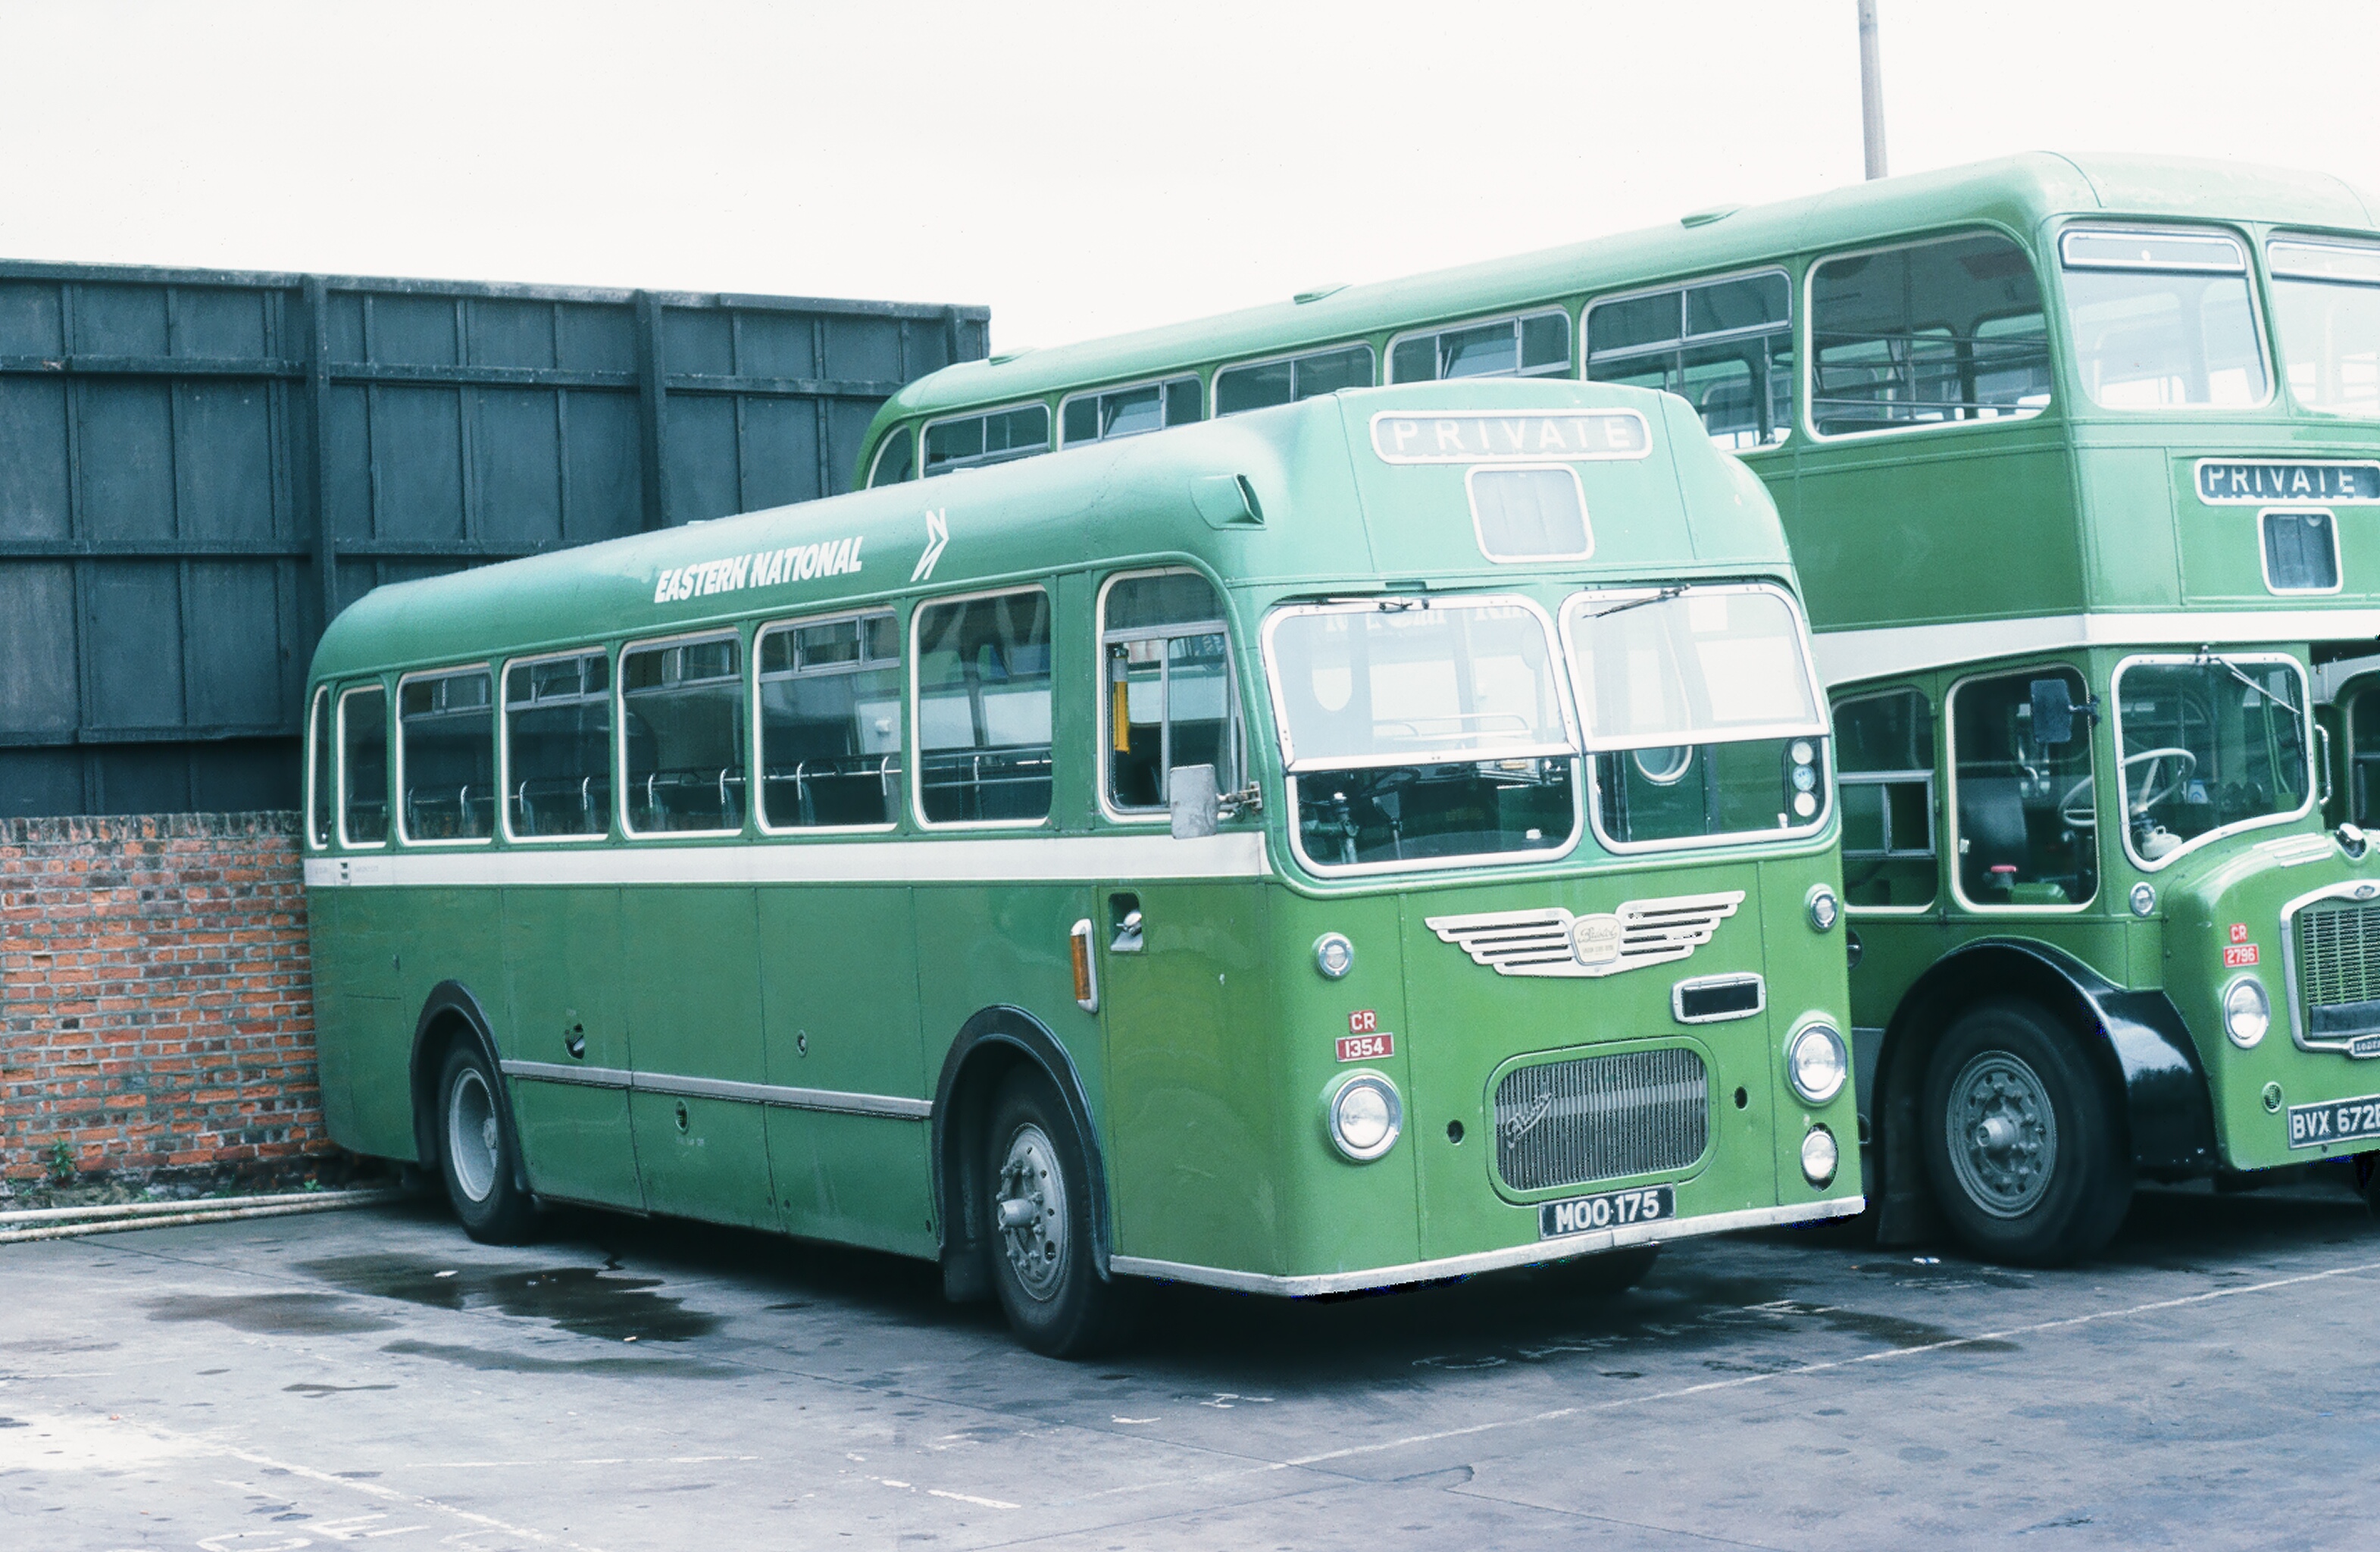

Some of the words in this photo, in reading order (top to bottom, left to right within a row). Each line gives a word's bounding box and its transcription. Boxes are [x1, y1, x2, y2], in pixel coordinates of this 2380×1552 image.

[1392, 418, 1631, 451] PRIVATE
[2208, 467, 2356, 493] PRIVATE
[654, 554, 752, 603] EASTERN
[749, 535, 864, 588] NATIONAL
[2231, 925, 2247, 941] CR
[2227, 947, 2256, 964] 2796
[1351, 1012, 1375, 1030] CR
[1345, 1037, 1384, 1058] 1354
[2293, 1109, 2331, 1140] BVX
[1556, 1198, 1609, 1233] MOO
[1615, 1191, 1659, 1222] 175
